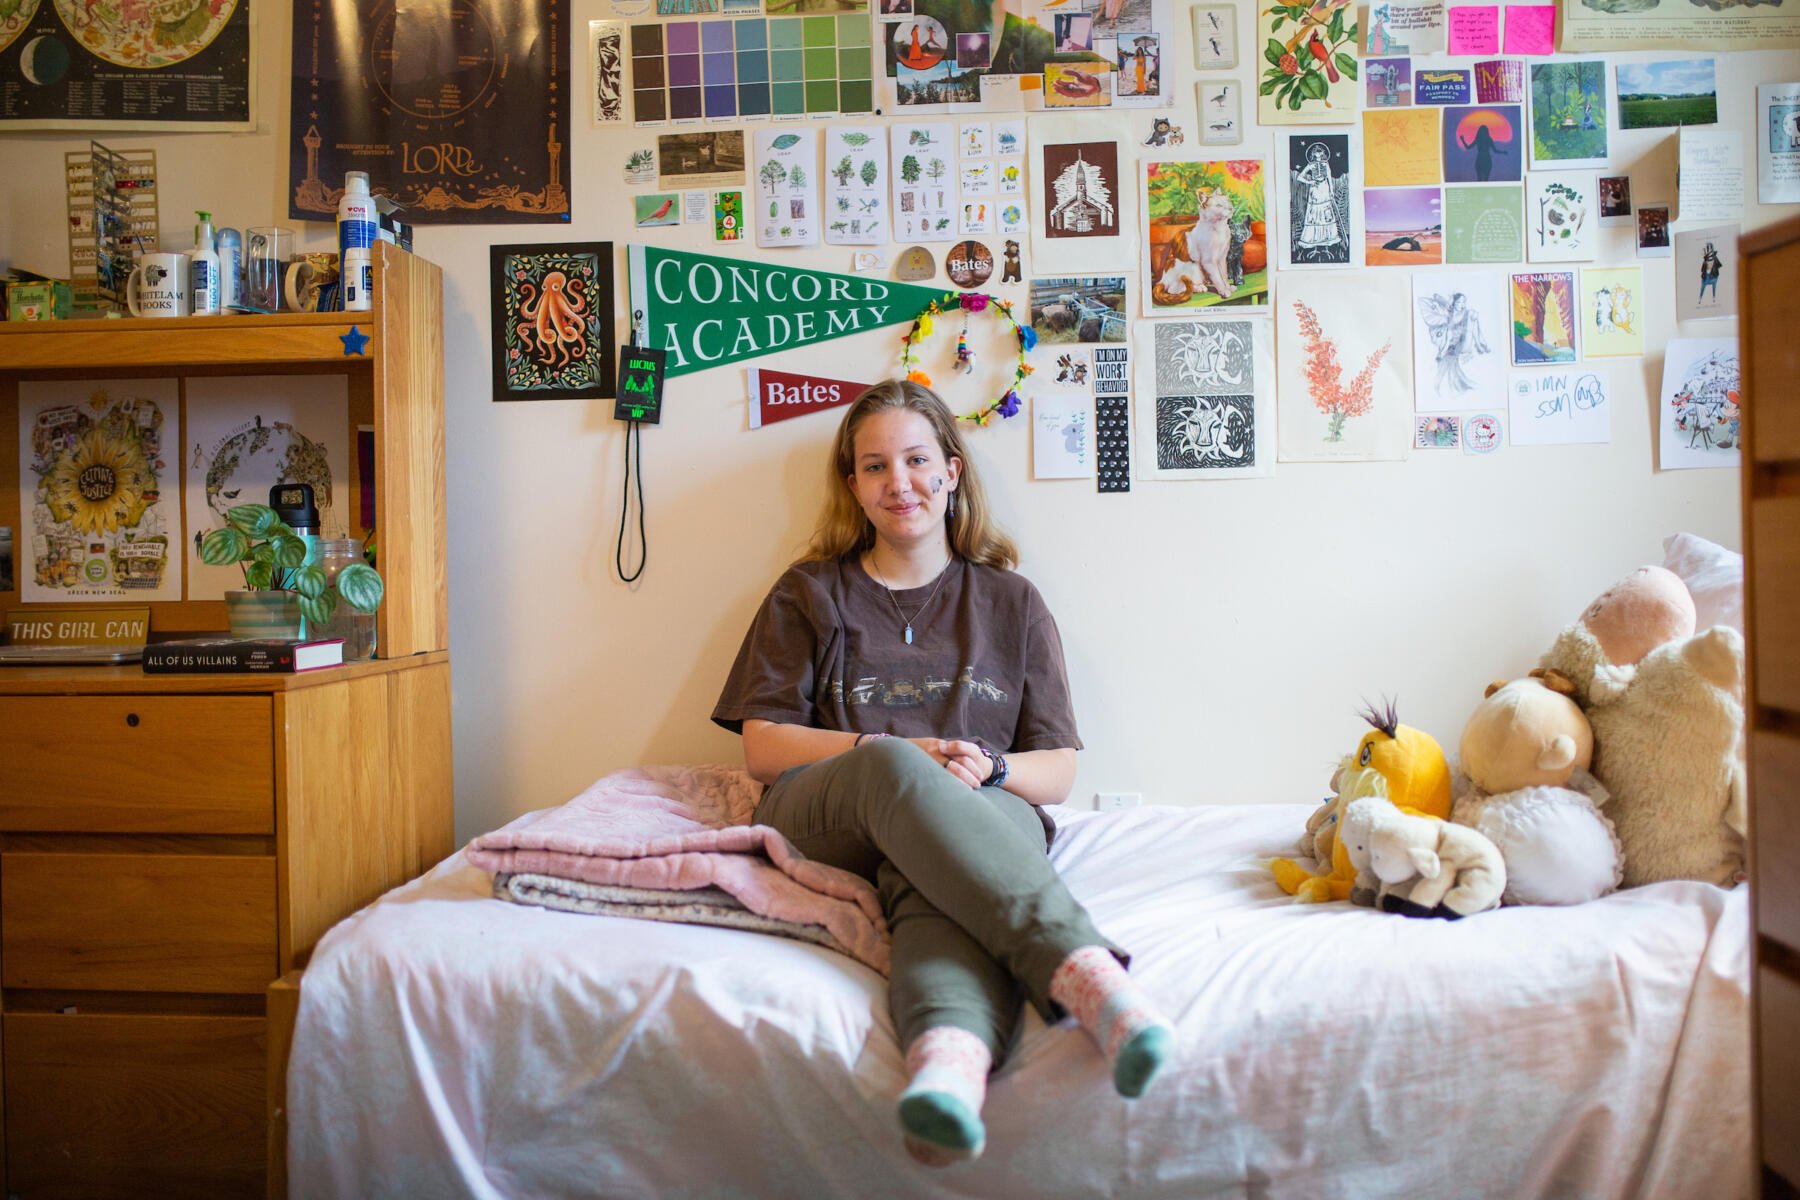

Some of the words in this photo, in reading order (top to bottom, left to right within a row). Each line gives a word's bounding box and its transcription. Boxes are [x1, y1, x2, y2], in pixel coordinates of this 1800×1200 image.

[951, 258, 990, 271] Bates
[654, 258, 889, 304] CONCORD
[1513, 275, 1529, 283] THE
[1530, 272, 1572, 281] NARROWS
[664, 305, 891, 368] ACADEMY
[1116, 349, 1127, 360] MY
[1096, 380, 1128, 392] BEHAVIOR
[766, 380, 841, 406] Bates
[632, 408, 645, 418] VIP
[81, 484, 112, 500] JUSTICE
[12, 622, 54, 639] THIS
[59, 621, 100, 639] GIRL
[105, 620, 144, 638] CAN
[148, 656, 163, 665] ALL
[166, 656, 179, 665] OF
[182, 656, 194, 665] US
[196, 656, 237, 665] VILLAINS
